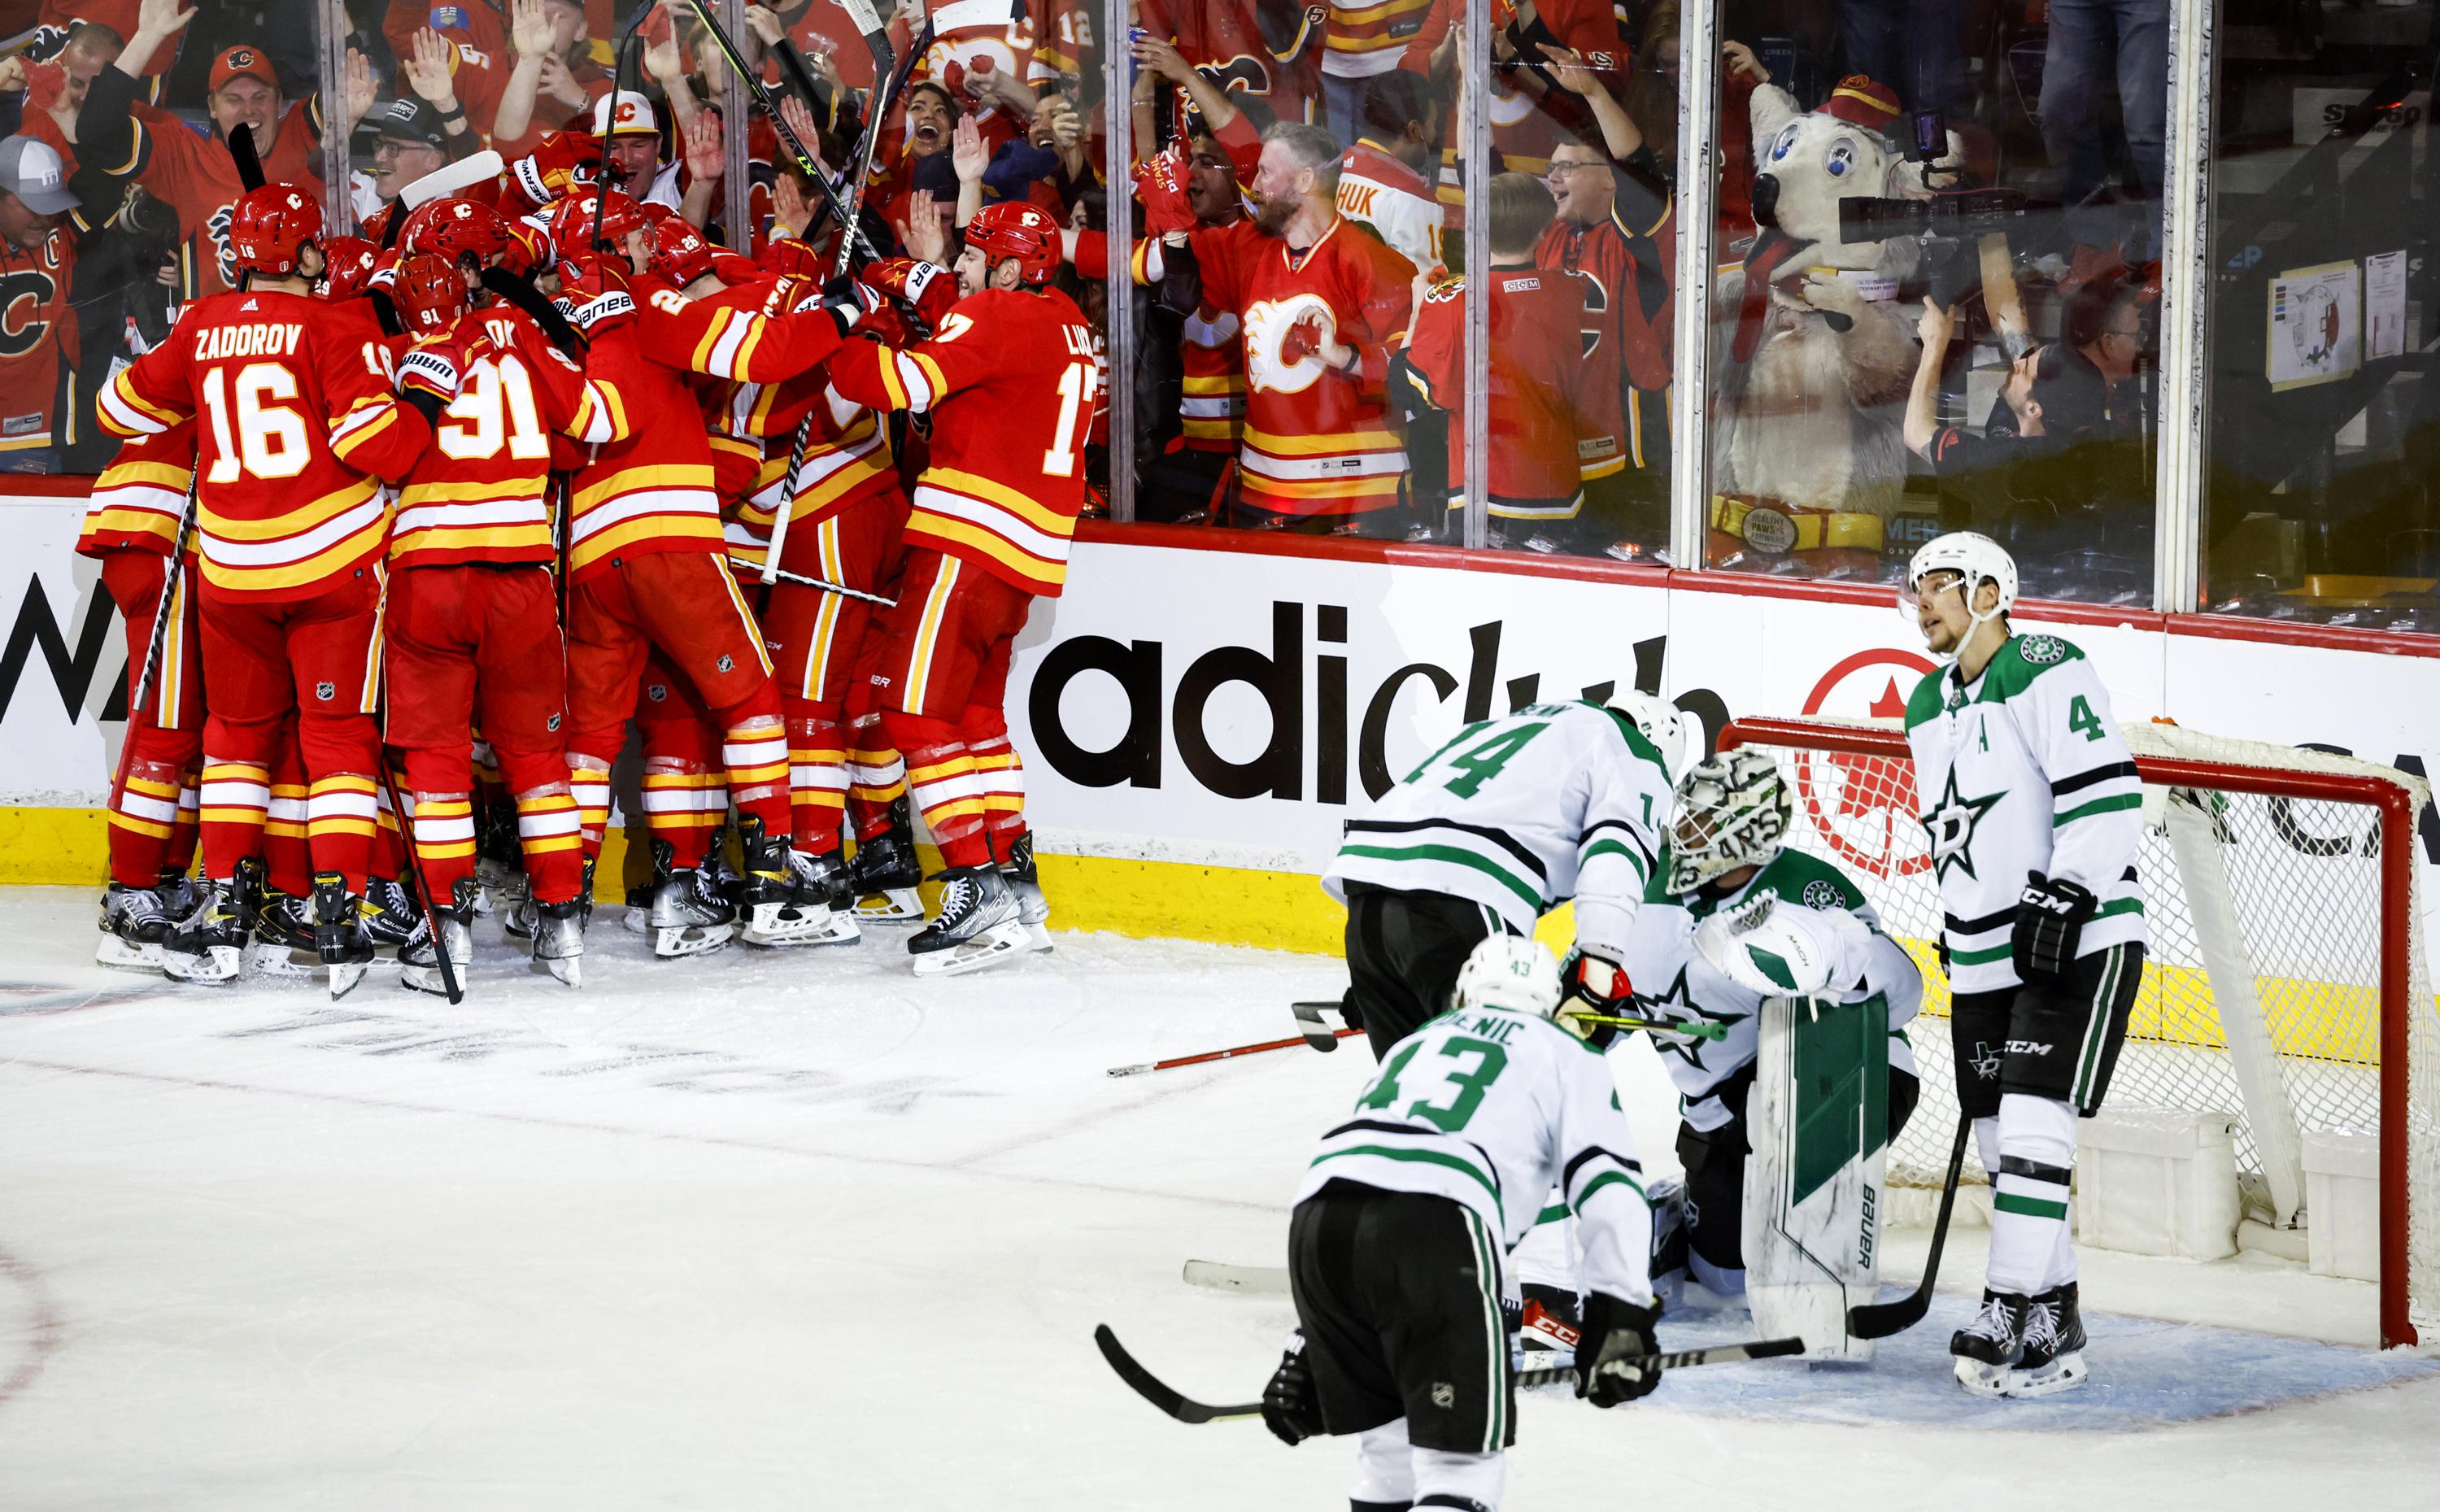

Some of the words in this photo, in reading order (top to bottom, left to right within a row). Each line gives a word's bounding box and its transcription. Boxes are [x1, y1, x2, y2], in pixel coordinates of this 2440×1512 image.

[240, 244, 255, 259] 16
[681, 234, 699, 250] 26
[839, 213, 859, 273] ALPHA
[1503, 279, 1540, 292] CCM
[420, 307, 442, 325] 91
[195, 323, 303, 361] ZADOROV
[438, 353, 550, 460] 91
[203, 362, 311, 483] 16
[1751, 514, 1785, 526] HEALTHY
[1751, 523, 1776, 534] PAWS
[1750, 534, 1785, 544] FORWARD
[1978, 712, 1989, 755] A
[2069, 694, 2106, 742] 4
[1403, 720, 1553, 800] 14
[381, 917, 408, 934] BAUER
[424, 909, 437, 943] BAUER
[670, 895, 711, 926] VAPOR
[697, 904, 719, 920] BAUER
[1510, 960, 1532, 977] 43
[1355, 1034, 1509, 1132] 43
[1858, 1183, 1876, 1270] BAUER
[1534, 1314, 1580, 1345] CC
